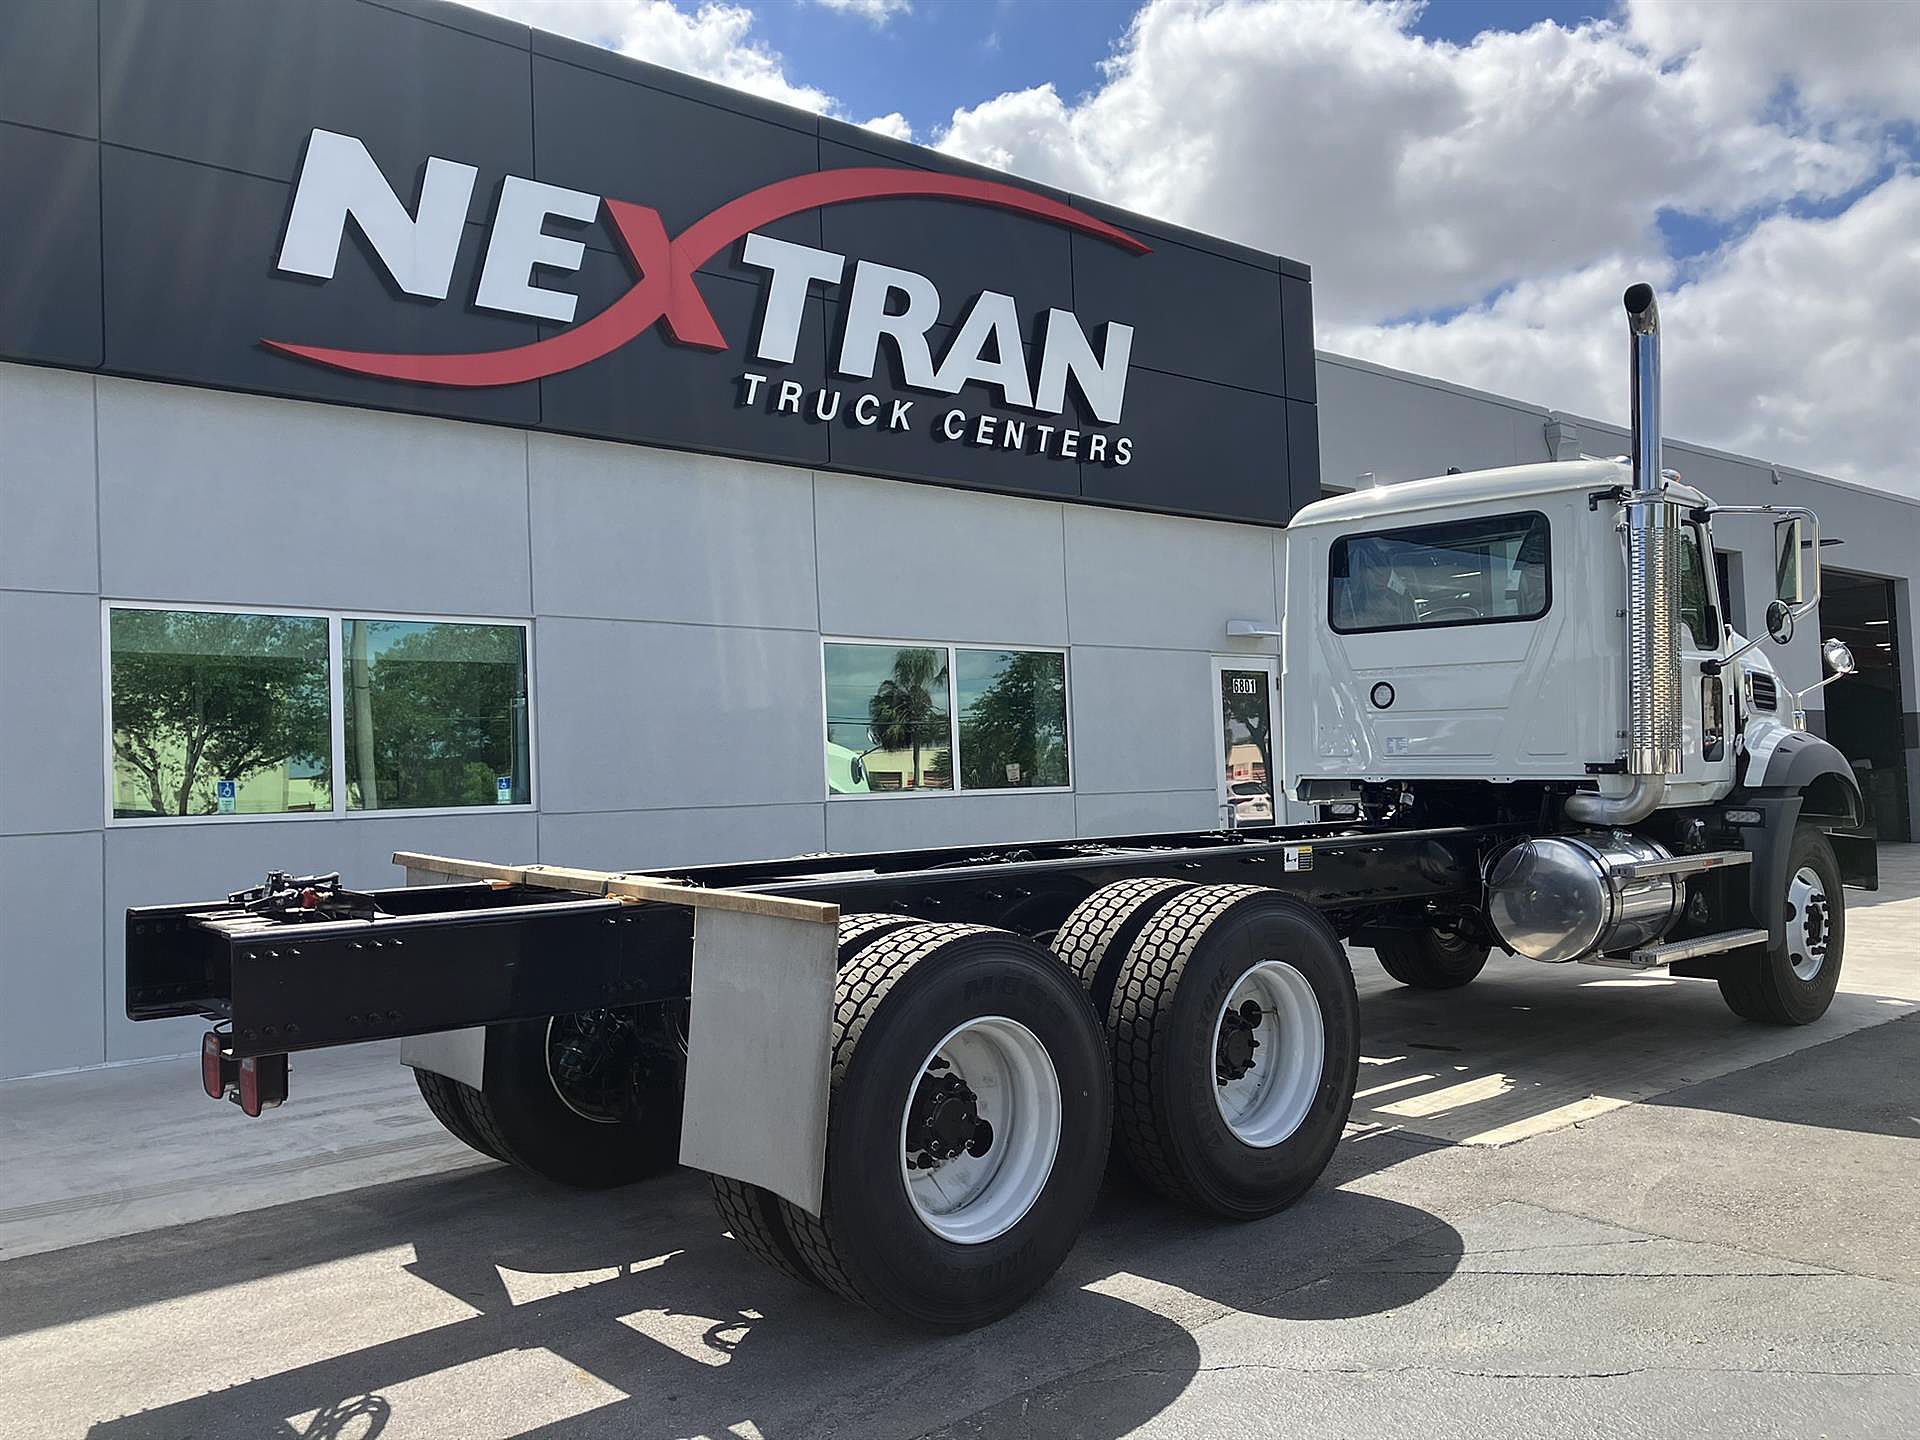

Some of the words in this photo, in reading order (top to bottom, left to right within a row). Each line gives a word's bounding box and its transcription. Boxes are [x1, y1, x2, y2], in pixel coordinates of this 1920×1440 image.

[276, 128, 1135, 425] NEXTRAN
[742, 372, 914, 431] TRUCK
[943, 409, 1134, 466] CENTERS
[1234, 679, 1255, 693] 6801
